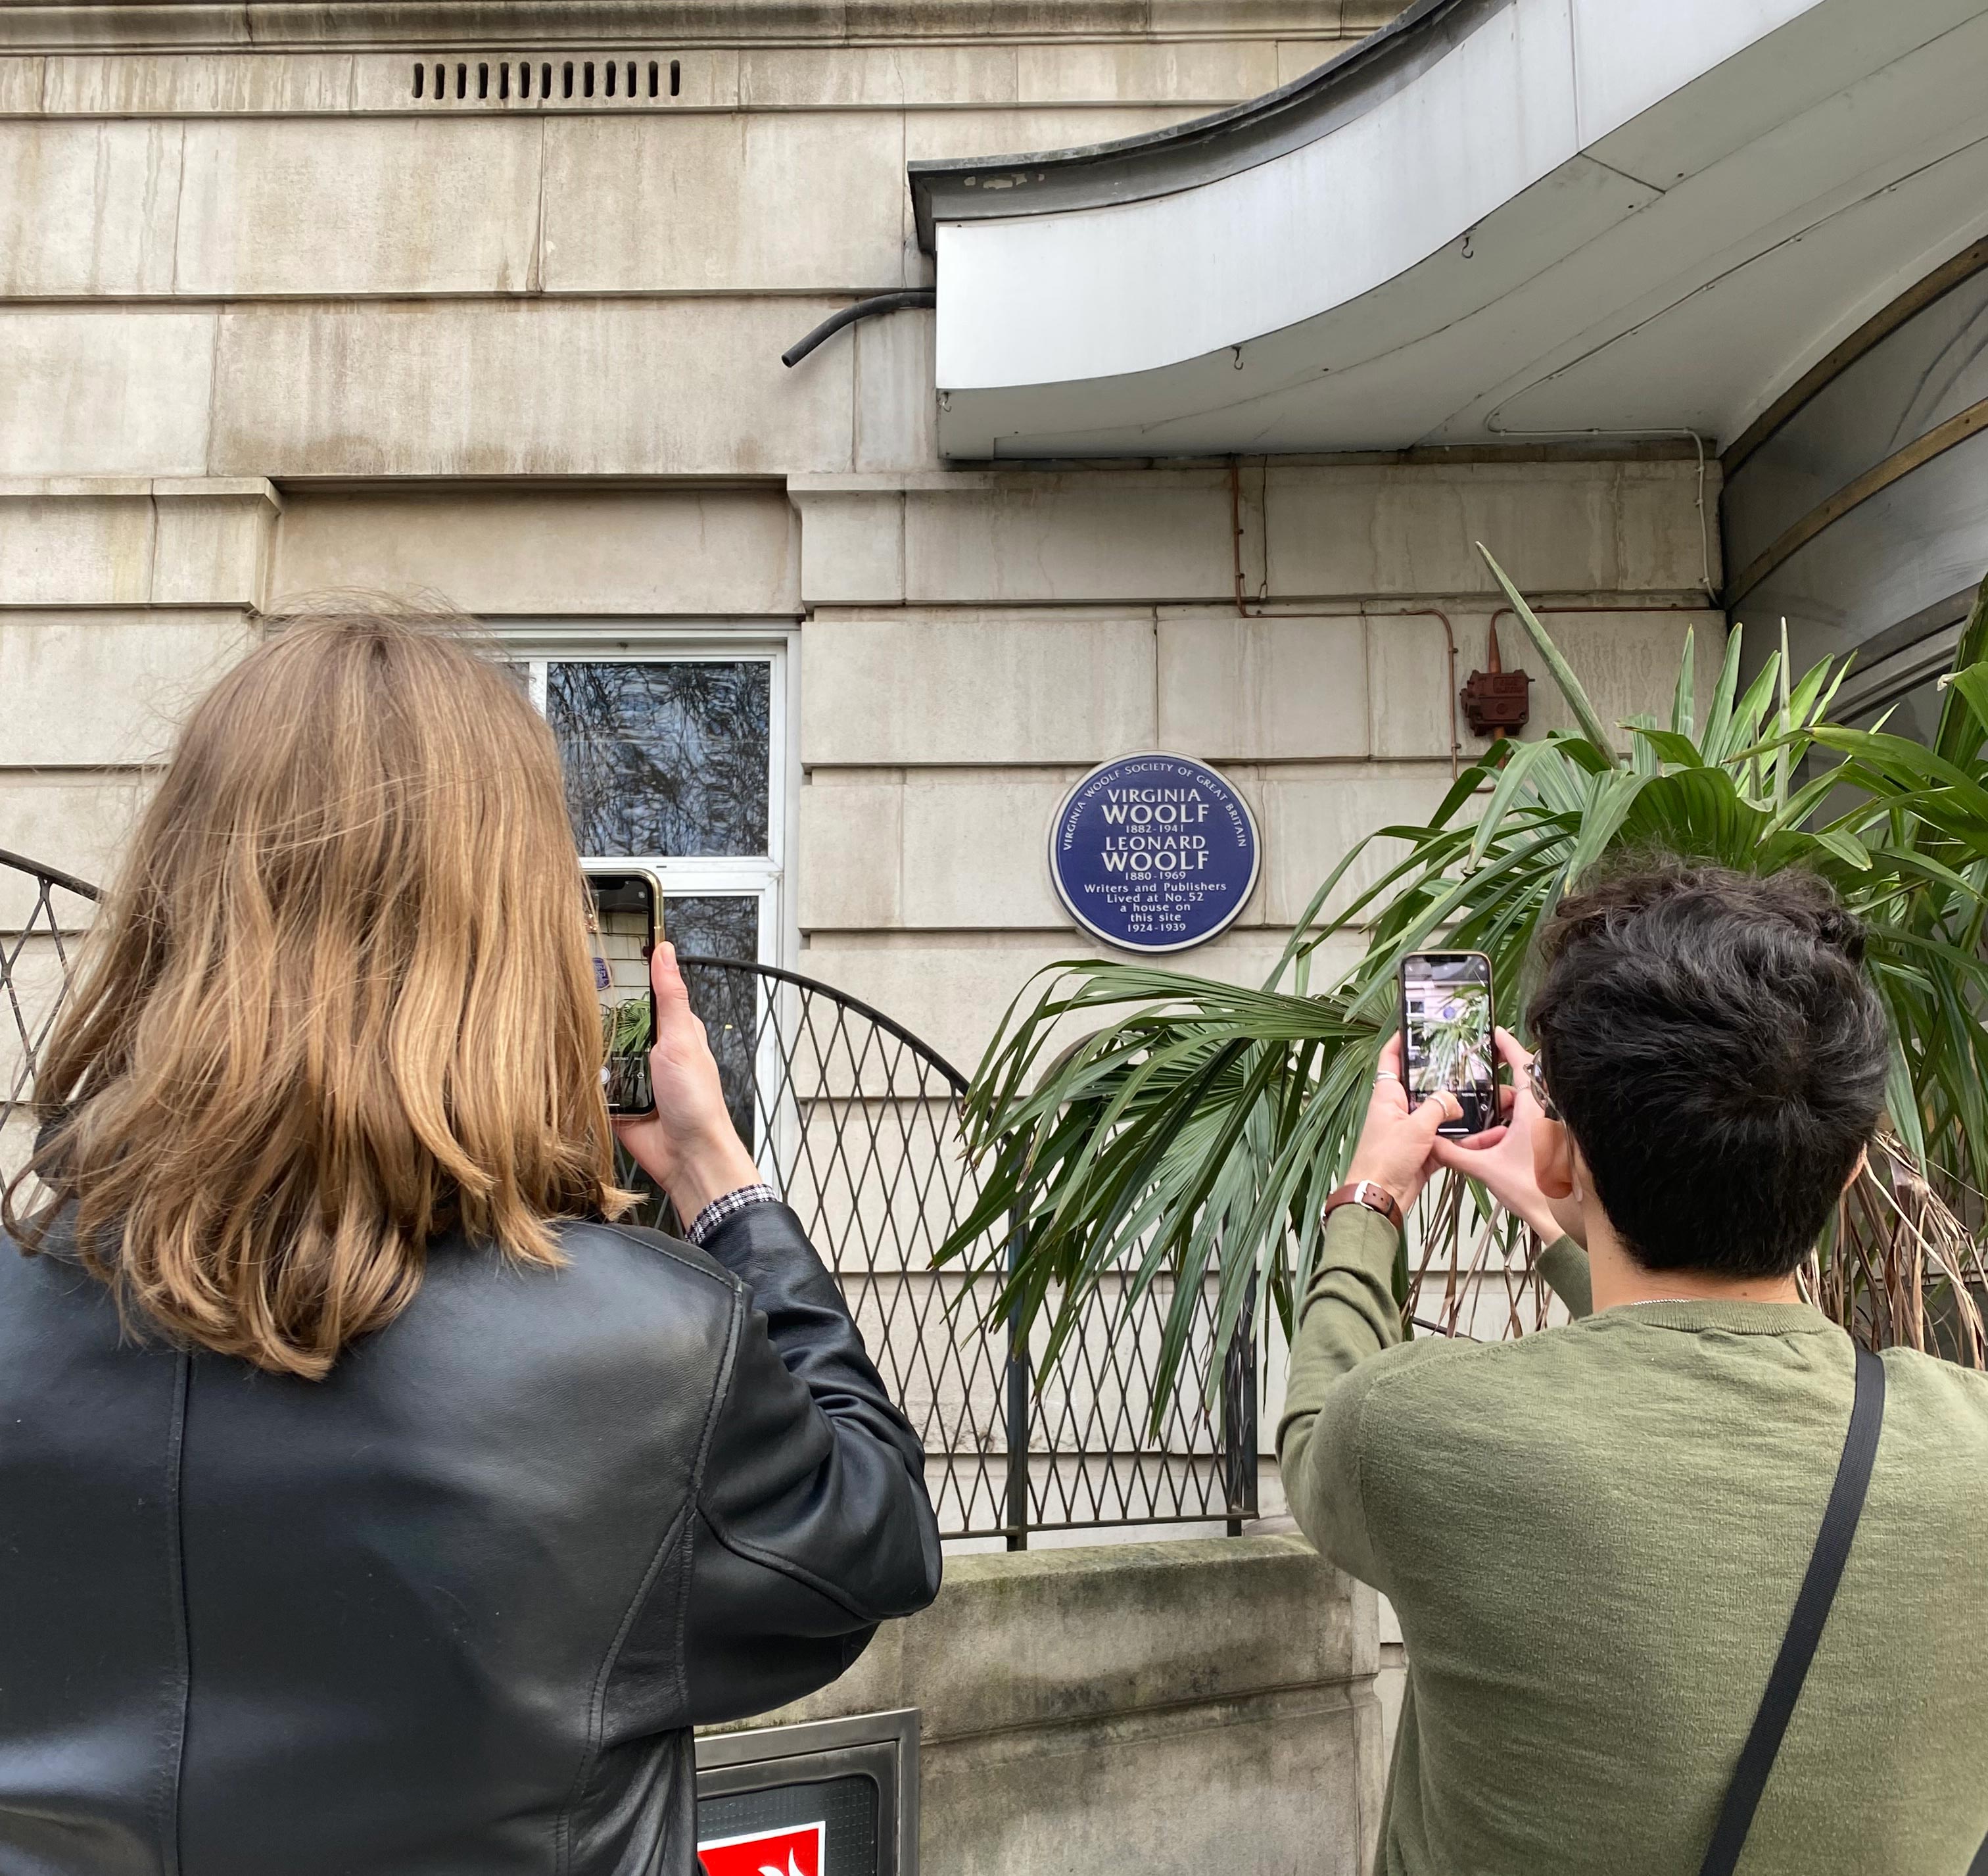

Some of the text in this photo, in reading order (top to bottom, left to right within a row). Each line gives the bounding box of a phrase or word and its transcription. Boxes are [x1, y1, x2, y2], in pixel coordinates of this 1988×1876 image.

[1106, 788, 1202, 803] VIRGINIA
[1063, 763, 1246, 851] VIRGINIA WOOLF SOCIETY OF GREAT BRITAIN
[1100, 804, 1209, 825] WOOLF
[1105, 836, 1206, 851] LEONARD
[1100, 851, 1209, 872] WOOLF
[1084, 882, 1227, 893] Writers and Publishers
[1106, 894, 1141, 903] Lived
[1147, 894, 1159, 902] at
[1120, 904, 1127, 913] a
[1133, 903, 1170, 912] house
[1130, 913, 1152, 922] this
